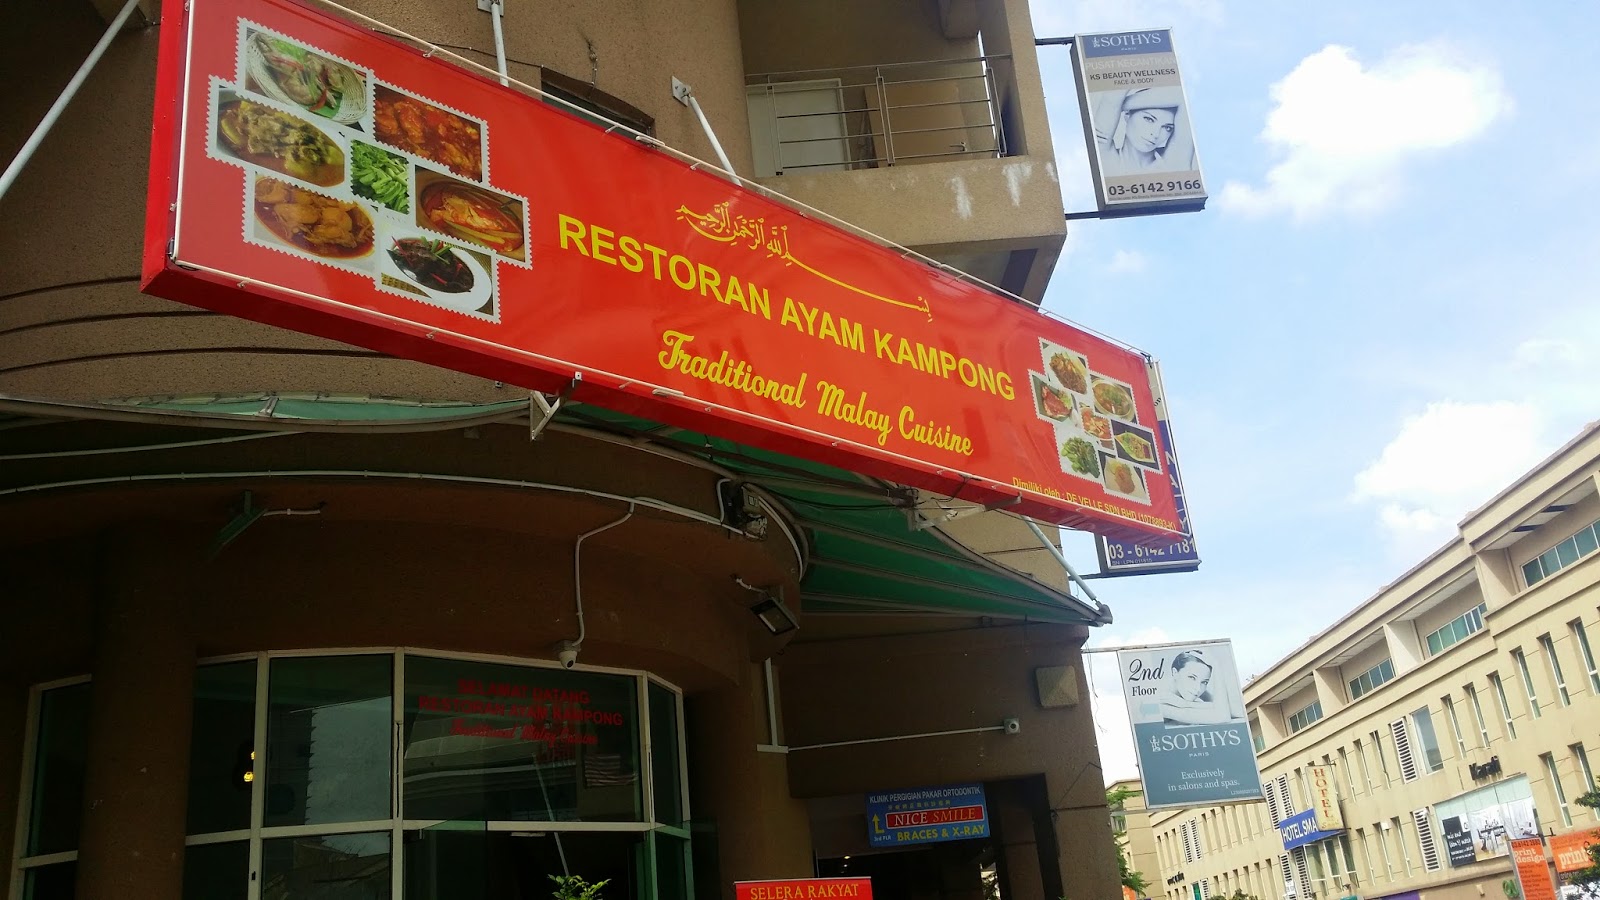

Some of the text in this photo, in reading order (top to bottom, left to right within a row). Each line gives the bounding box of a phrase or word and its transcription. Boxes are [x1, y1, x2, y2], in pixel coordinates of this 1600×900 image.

[1100, 32, 1162, 48] SOTHYS
[1089, 68, 1176, 81] KS BEAUTY WELLNESS
[1108, 182, 1165, 196] 03-6142
[1167, 180, 1201, 191] 9166
[558, 213, 1016, 401] RESTORAN AYAM KAMPONG
[658, 329, 974, 457] Traditional Malay Cuisine
[1066, 491, 1077, 503] DE
[1104, 503, 1120, 515] SDN
[1121, 507, 1137, 519] BHD
[1108, 543, 1124, 560] 03
[1128, 657, 1165, 682] 2nd
[457, 678, 590, 704] SELAMAT DATANG
[1131, 685, 1158, 697] Floor
[418, 695, 623, 726] RESTORAN AYAM KAMPONG
[1161, 729, 1241, 751] SOTHYS
[1181, 768, 1225, 780] Exclusively
[1168, 779, 1241, 792] in salons and spas.
[1313, 768, 1332, 818] HOTEL
[869, 786, 981, 804] KLINIK PERGIGIAN PAKAR ORTODONTIK
[894, 808, 976, 826] NICE SMILE
[896, 824, 985, 842] BRACES & X-RAY
[1281, 822, 1303, 843] HOTEL
[1513, 848, 1537, 858] print
[1516, 852, 1546, 864] design
[1557, 846, 1590, 869] print
[750, 883, 860, 900] SELERA RAKYAT
